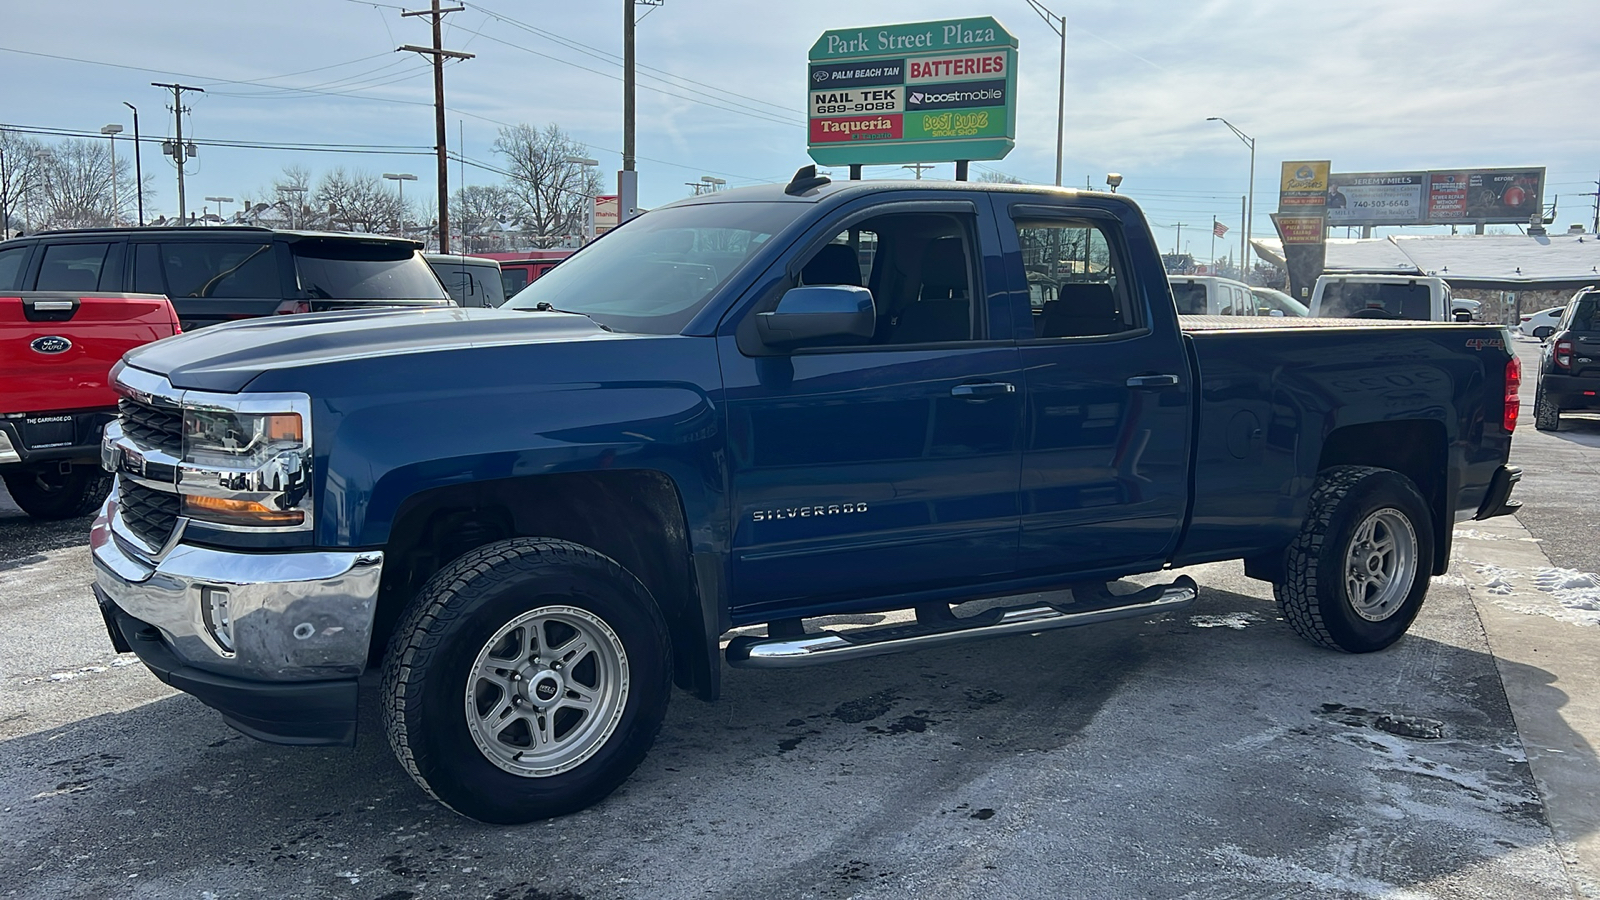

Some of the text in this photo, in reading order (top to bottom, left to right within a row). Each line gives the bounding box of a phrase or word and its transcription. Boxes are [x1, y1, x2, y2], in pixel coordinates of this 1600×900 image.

[827, 23, 995, 54] Park Street Plaza
[831, 66, 900, 80] PALM BEACH TAN
[910, 56, 1004, 79] BATTERIES
[815, 89, 896, 105] NAIL TEK
[817, 101, 895, 114] 689-9088
[932, 128, 978, 137] SMOKE SHOP
[1353, 176, 1412, 186] JEREMY MILLS
[41, 339, 64, 351] Ford
[37, 416, 63, 424] CARRIAGE
[753, 502, 868, 522] SILVERADO
